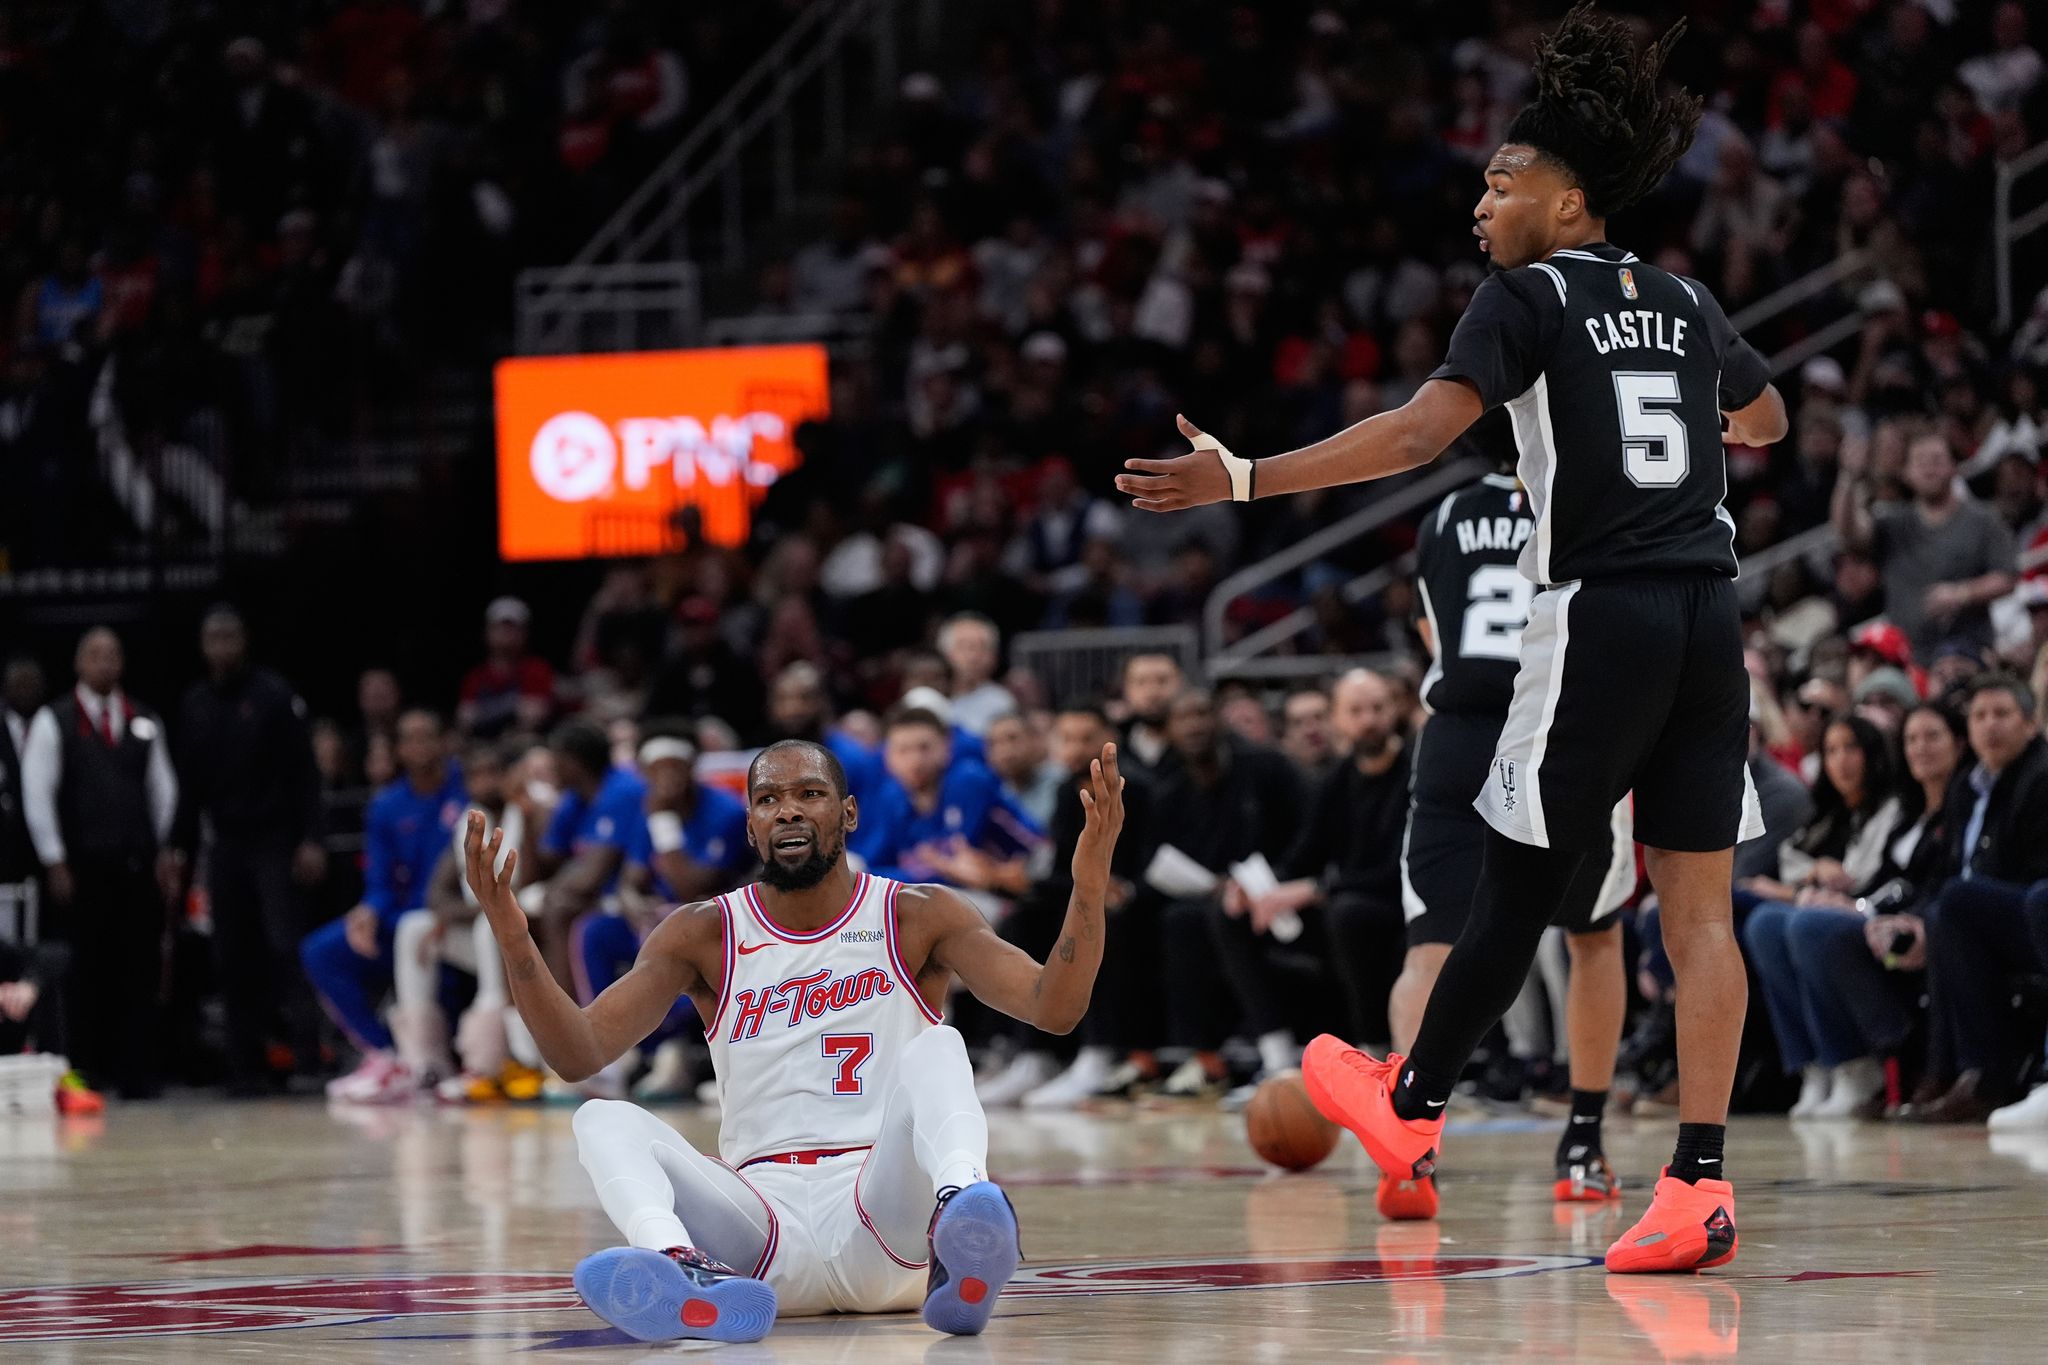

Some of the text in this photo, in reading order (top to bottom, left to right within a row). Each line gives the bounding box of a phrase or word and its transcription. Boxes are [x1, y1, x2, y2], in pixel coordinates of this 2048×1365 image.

[1585, 310, 1688, 357] CASTLE
[618, 411, 785, 490] PNC
[1611, 371, 1690, 488] 5
[1456, 517, 1536, 554] HARP
[1458, 563, 1537, 662] 2
[729, 967, 894, 1043] H-Town
[821, 1033, 873, 1095] 7
